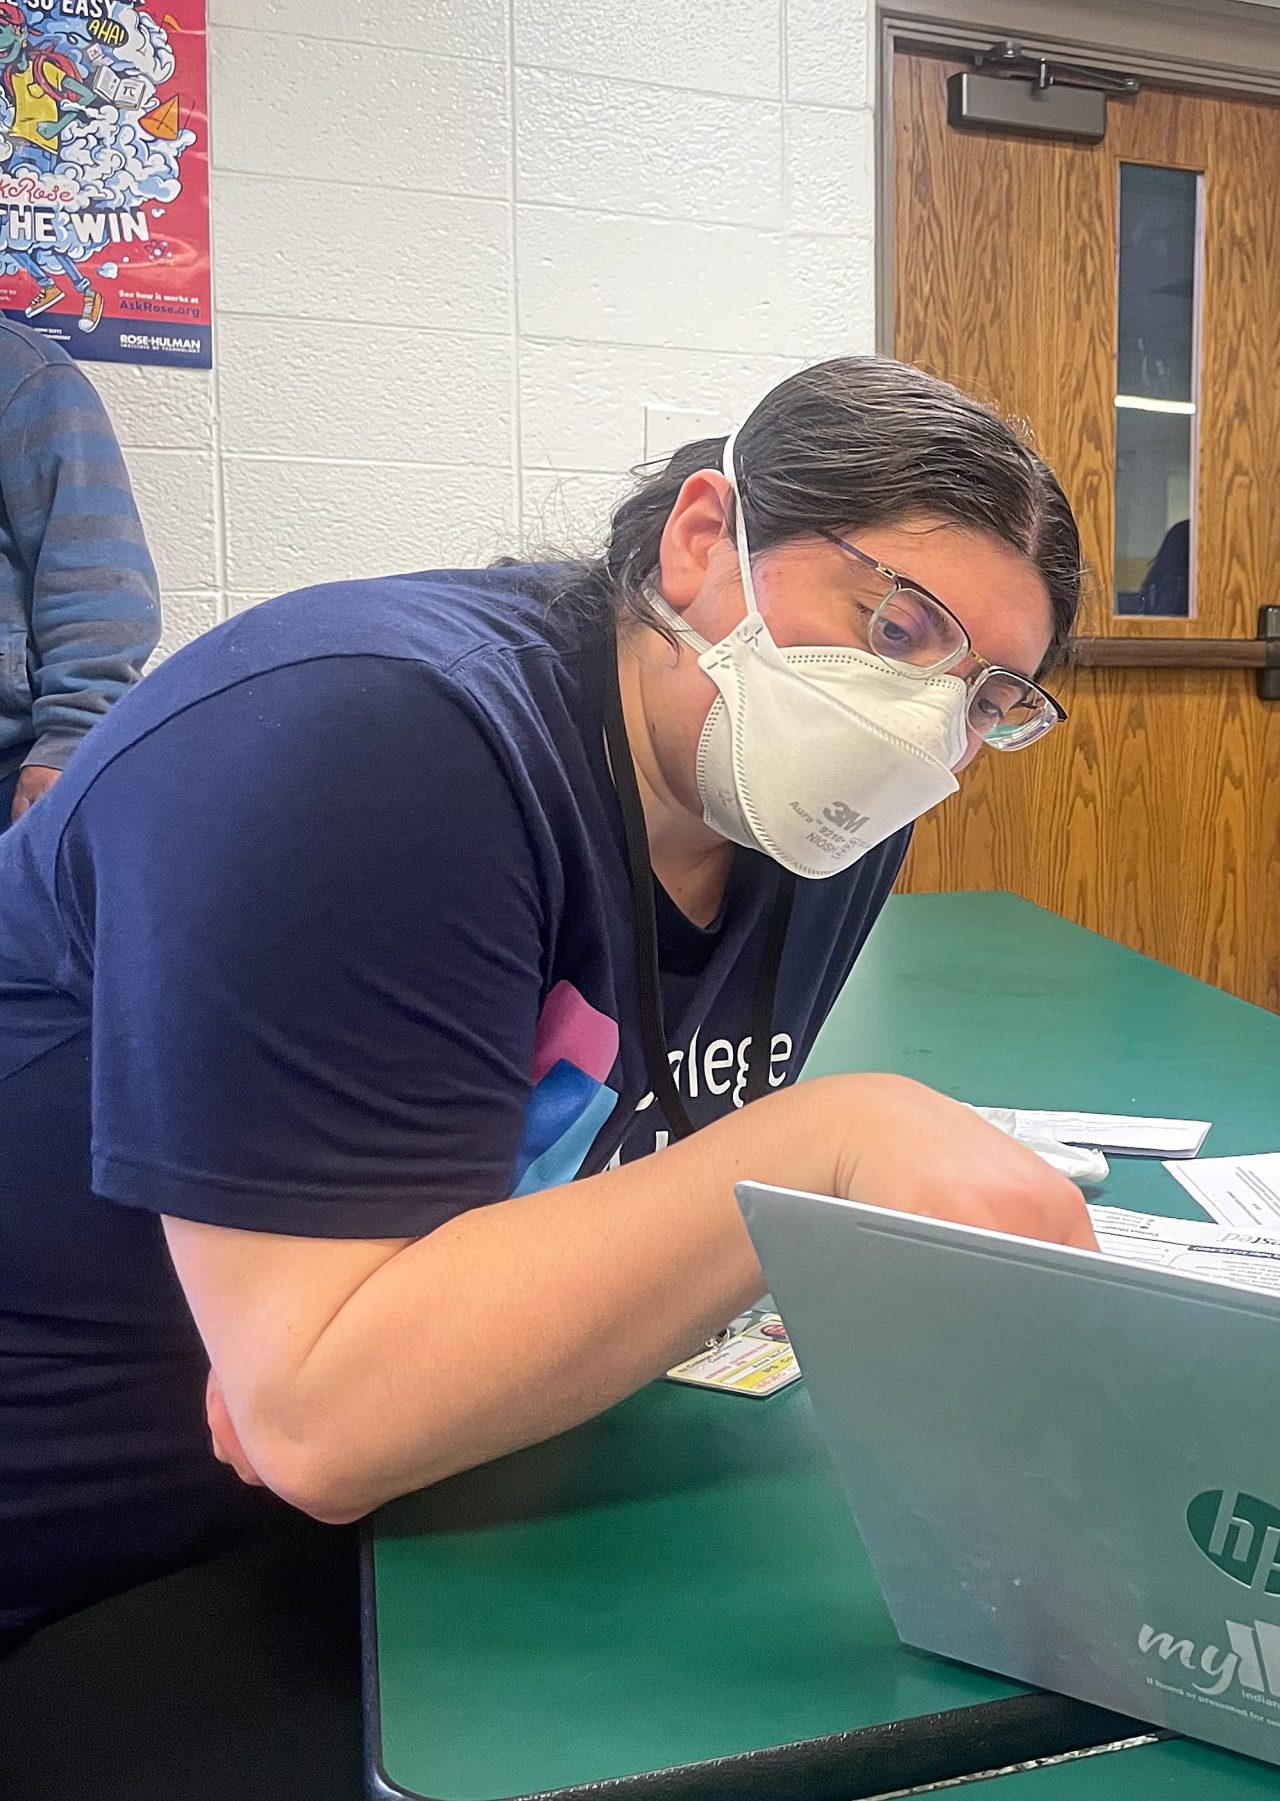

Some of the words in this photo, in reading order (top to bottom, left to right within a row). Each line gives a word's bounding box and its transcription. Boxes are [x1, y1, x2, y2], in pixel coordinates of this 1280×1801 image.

[62, 0, 118, 18] EASY
[89, 19, 125, 46] AHA!
[71, 211, 150, 243] WIN
[119, 299, 200, 319] AskRose.org
[823, 801, 871, 834] 3M
